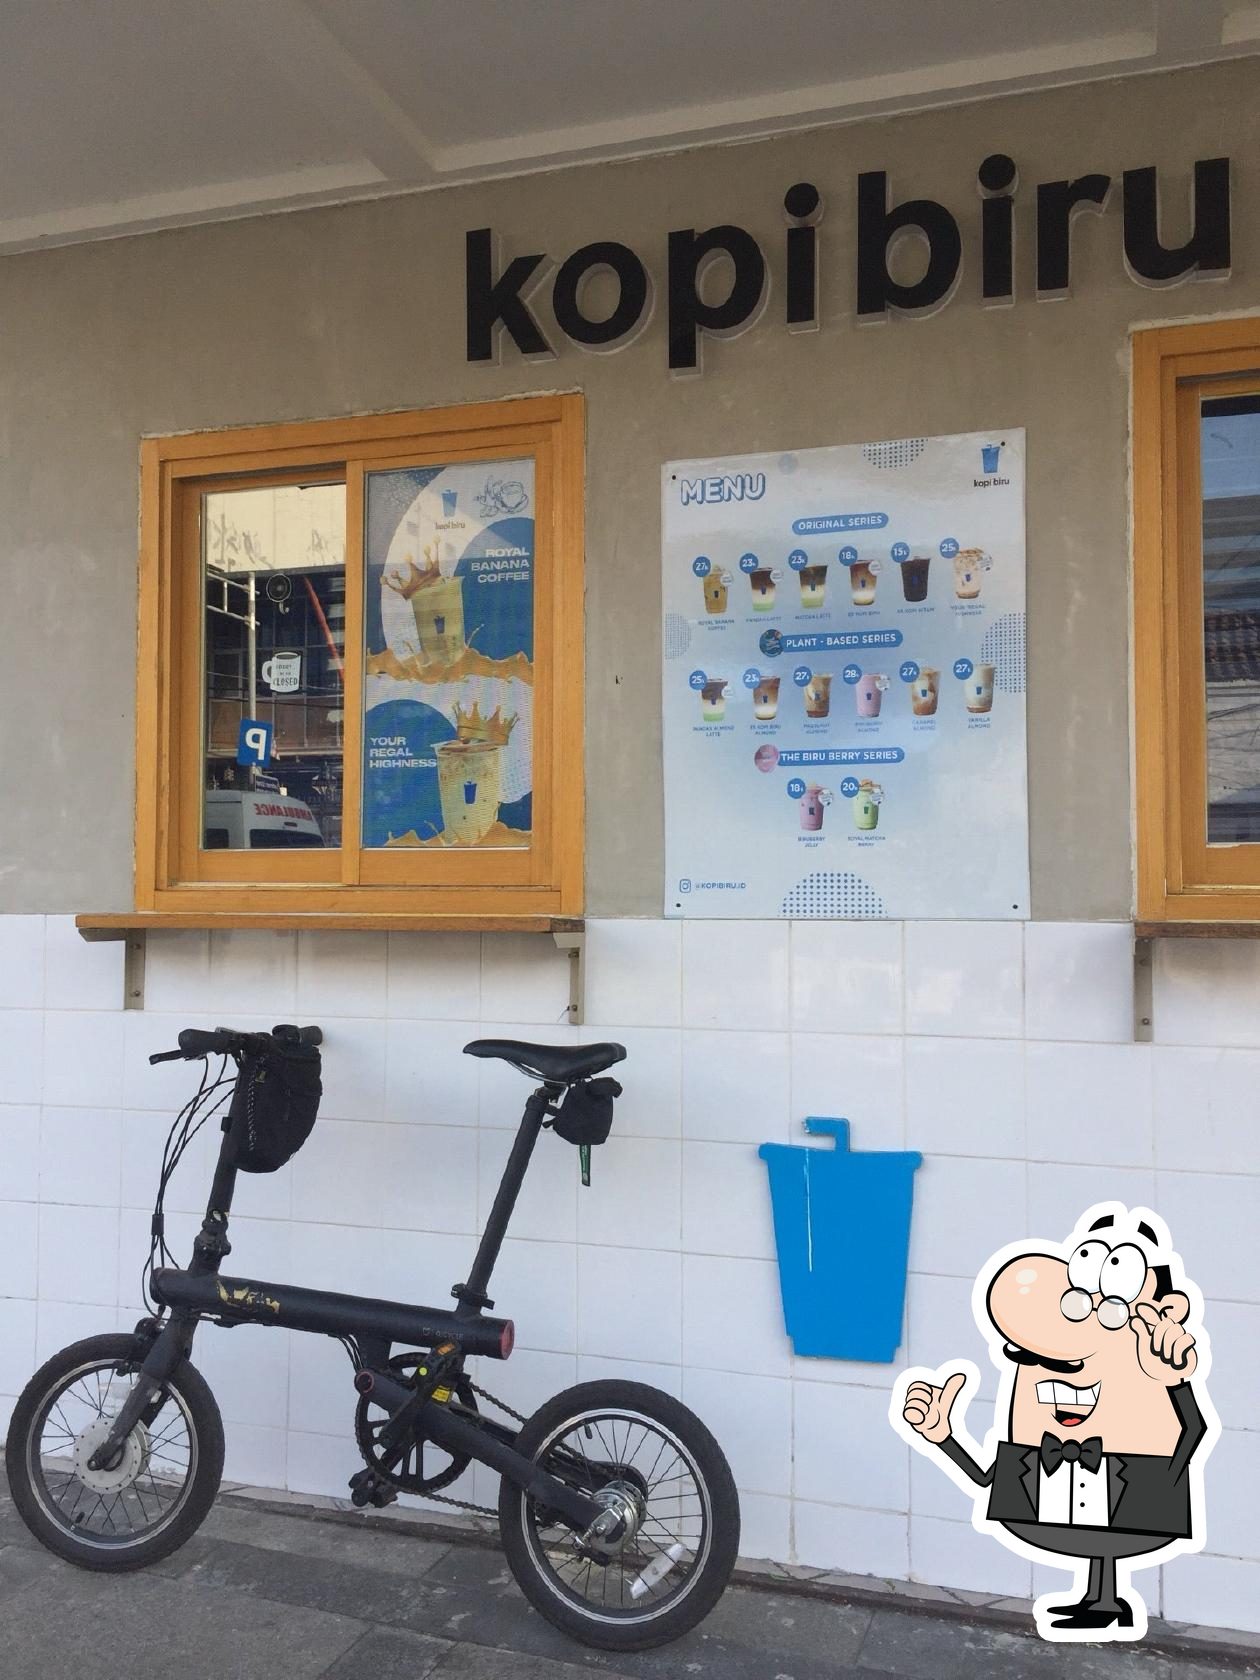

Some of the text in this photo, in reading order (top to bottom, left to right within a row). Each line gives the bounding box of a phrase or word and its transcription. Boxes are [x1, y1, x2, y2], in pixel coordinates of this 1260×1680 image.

[973, 477, 1010, 488] kopi biru
[681, 473, 766, 506] MENU
[798, 515, 882, 530] ORIGINAL SERIES
[485, 547, 530, 557] ROYAL
[471, 559, 530, 571] BANANA
[477, 571, 530, 583] COFFEE
[786, 637, 817, 648] PLANT
[826, 635, 859, 646] BASED
[862, 633, 896, 644] SERIES
[272, 677, 298, 687] CLOSED
[370, 736, 407, 746] YOUR
[369, 747, 414, 757] REGAL
[780, 750, 898, 761] THE BIRU BERRY SERIES
[369, 758, 437, 768] HIGHNESS
